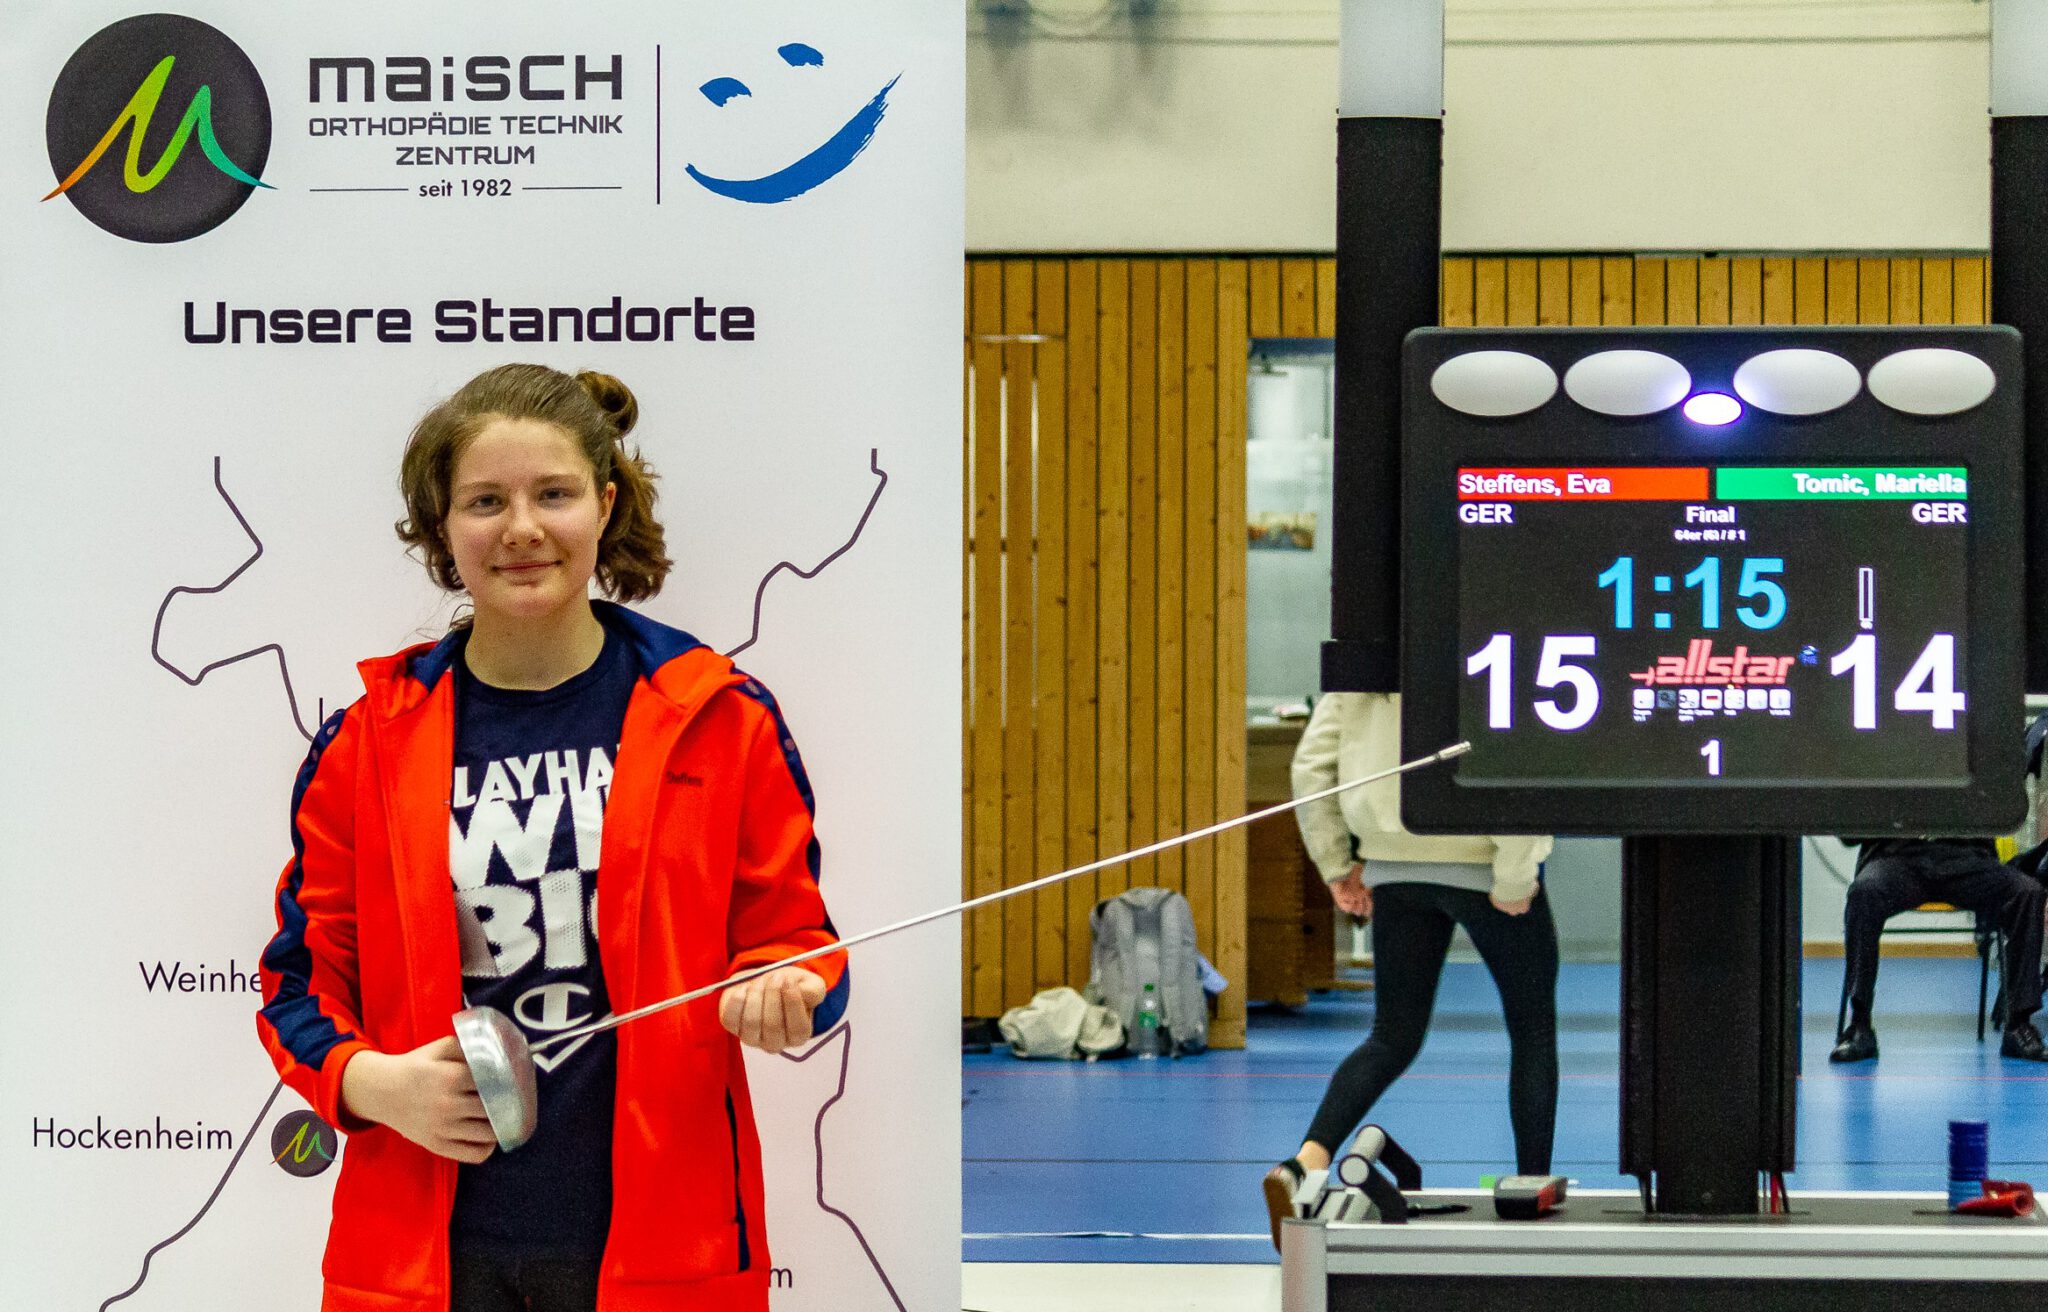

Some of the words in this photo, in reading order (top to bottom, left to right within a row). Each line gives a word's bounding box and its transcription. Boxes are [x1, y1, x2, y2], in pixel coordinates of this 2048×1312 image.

[309, 111, 492, 137] ORTHOPÄDIE
[500, 114, 623, 135] TECHNIK
[396, 145, 535, 166] ZENTRUM
[419, 178, 453, 198] seit
[461, 178, 512, 197] 1982
[184, 301, 412, 344] Unsere
[434, 296, 755, 343] Standorte
[1459, 473, 1562, 496] Steffens,
[1567, 473, 1611, 494] Eva
[1792, 473, 1870, 496] Tomic,
[1875, 473, 1967, 493] Mariella
[1459, 503, 1513, 524] GER
[1686, 506, 1736, 523] Final
[1911, 502, 1968, 523] GER
[1598, 557, 1787, 630] 1:15
[1655, 638, 1796, 685] allstar
[1467, 634, 1600, 730] 15
[1830, 634, 1966, 730] 14
[1700, 739, 1720, 776] 1
[453, 744, 620, 808] LAYHA
[453, 867, 599, 978] BI
[138, 958, 262, 993] Weinhe
[33, 1115, 232, 1150] Hockenheim
